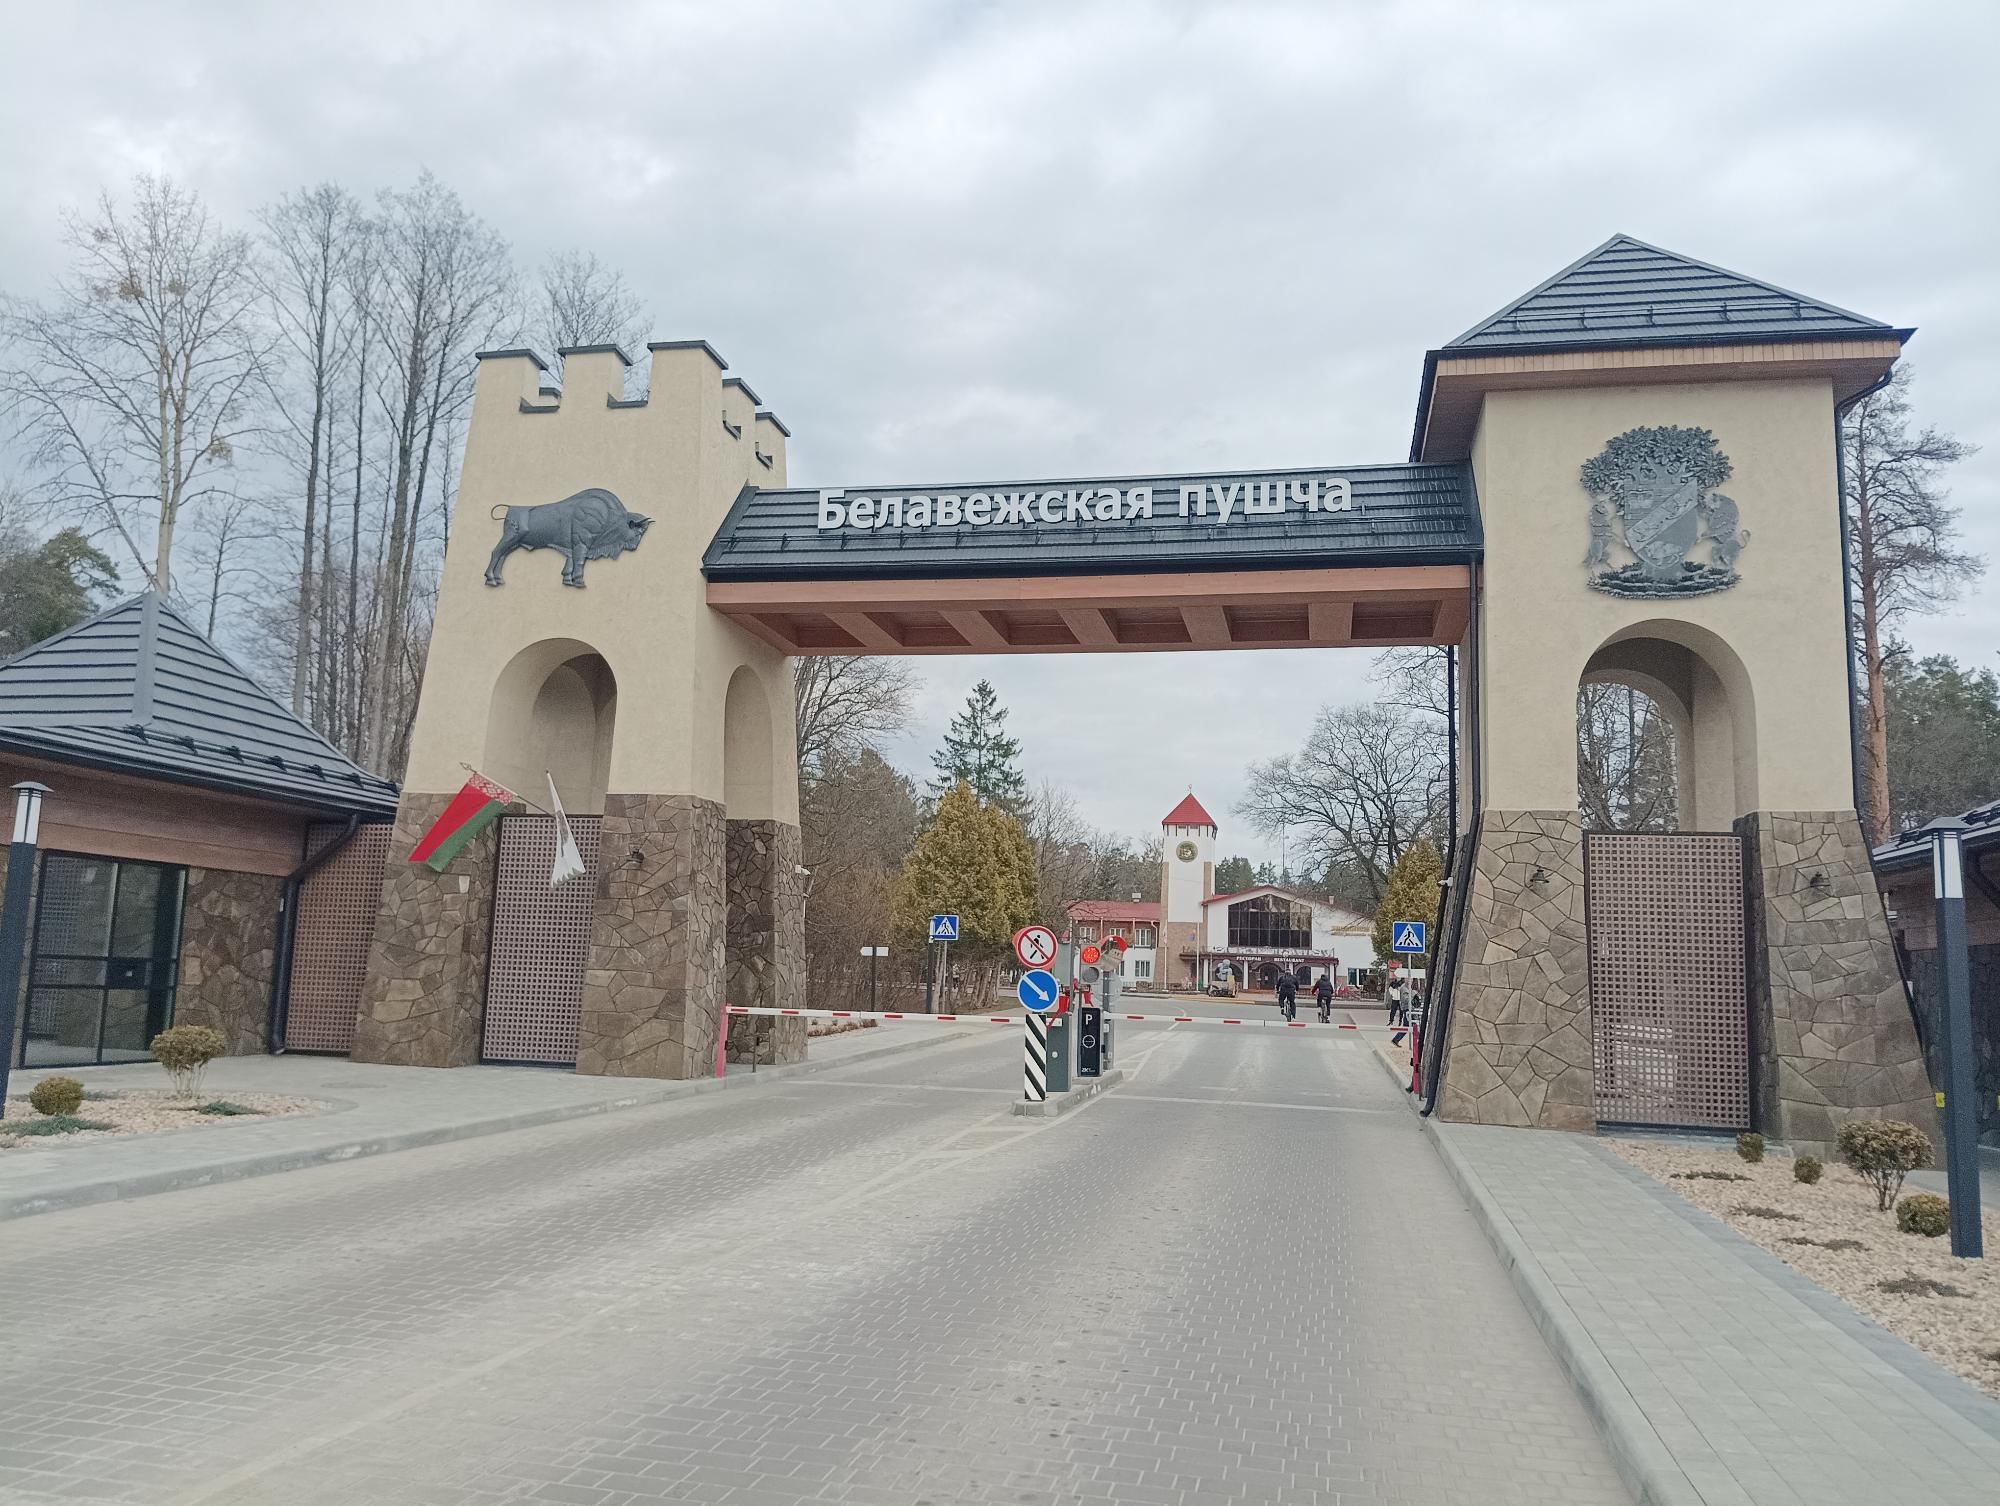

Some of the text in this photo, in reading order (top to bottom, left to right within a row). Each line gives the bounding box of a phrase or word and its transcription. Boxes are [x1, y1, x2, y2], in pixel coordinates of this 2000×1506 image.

[817, 476, 1352, 529] Белавежская пушча
[1086, 1014, 1093, 1025] P
